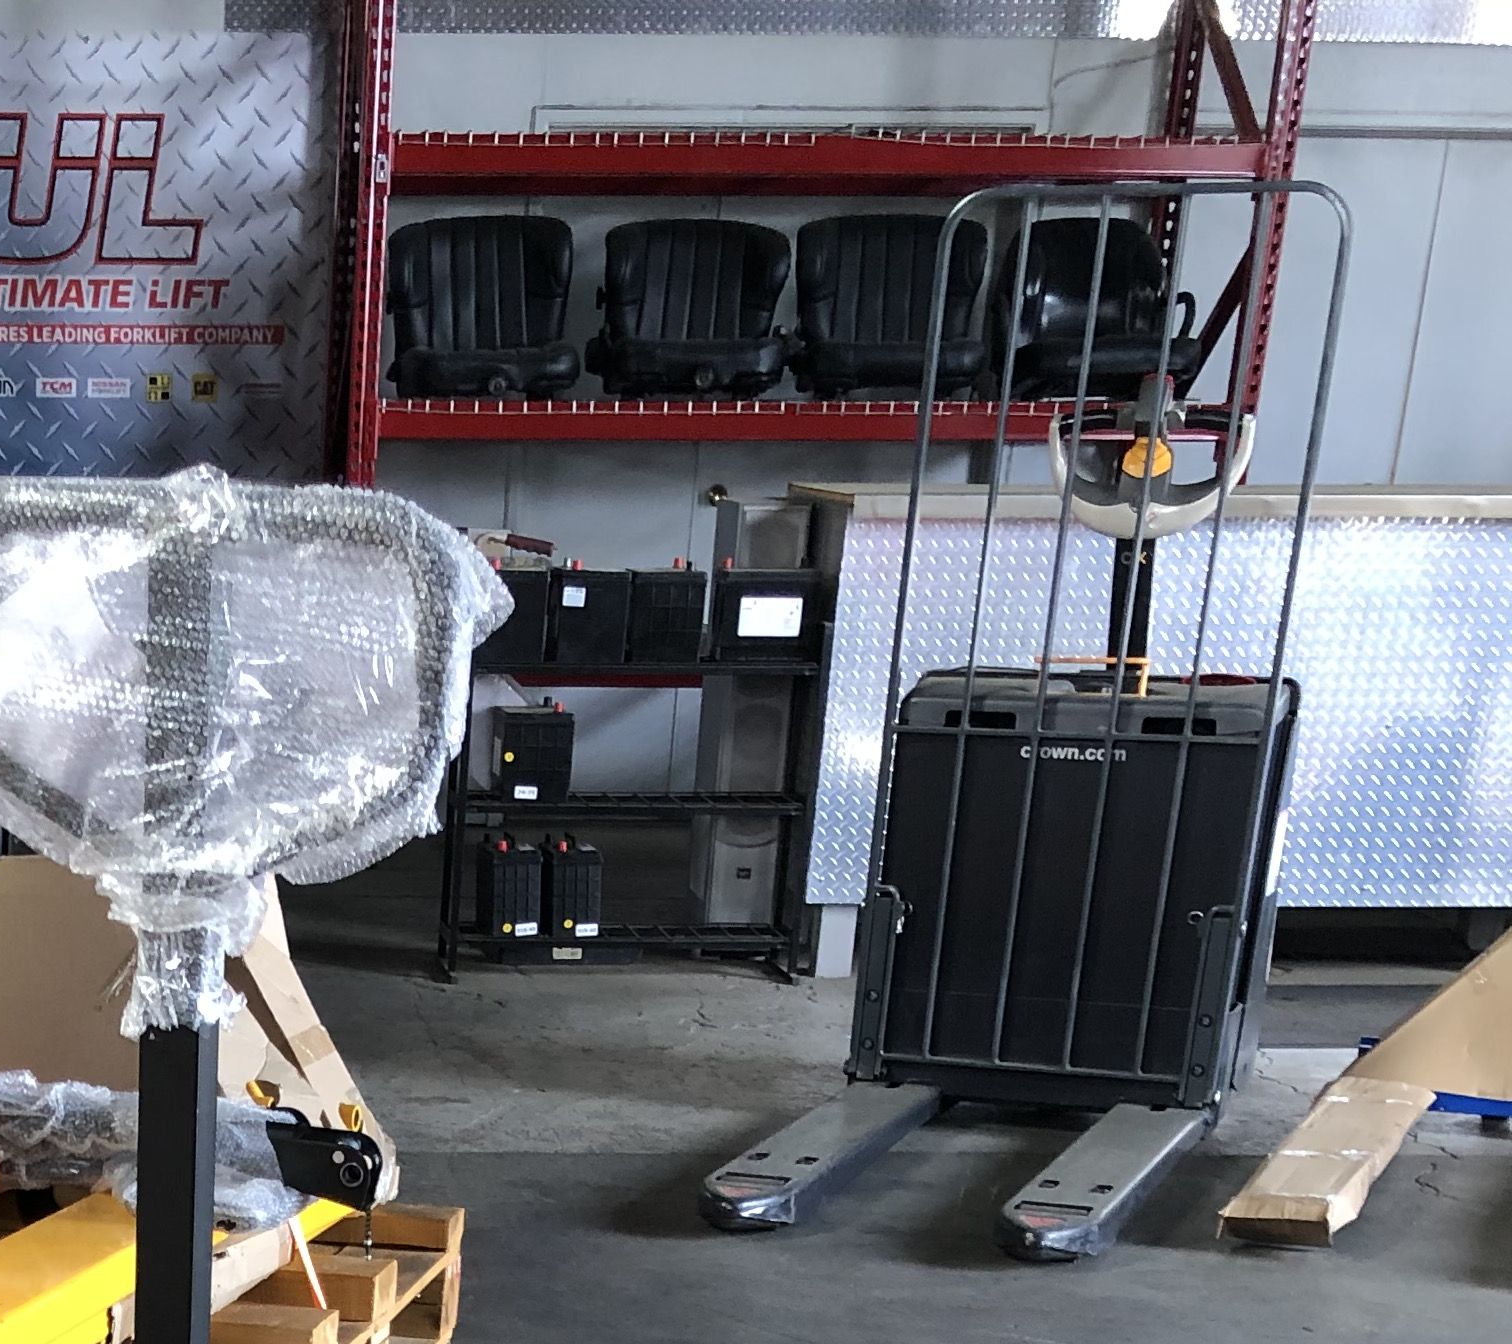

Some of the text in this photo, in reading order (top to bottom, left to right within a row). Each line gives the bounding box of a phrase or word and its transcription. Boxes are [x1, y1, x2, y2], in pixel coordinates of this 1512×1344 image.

[147, 277, 231, 310] LIFT
[33, 326, 105, 343] LEADING
[110, 327, 189, 343] FORKLIFT
[194, 327, 275, 343] COMPANY
[41, 381, 73, 395] TCM
[194, 380, 216, 396] CAT
[1020, 746, 1127, 761] cown.com
